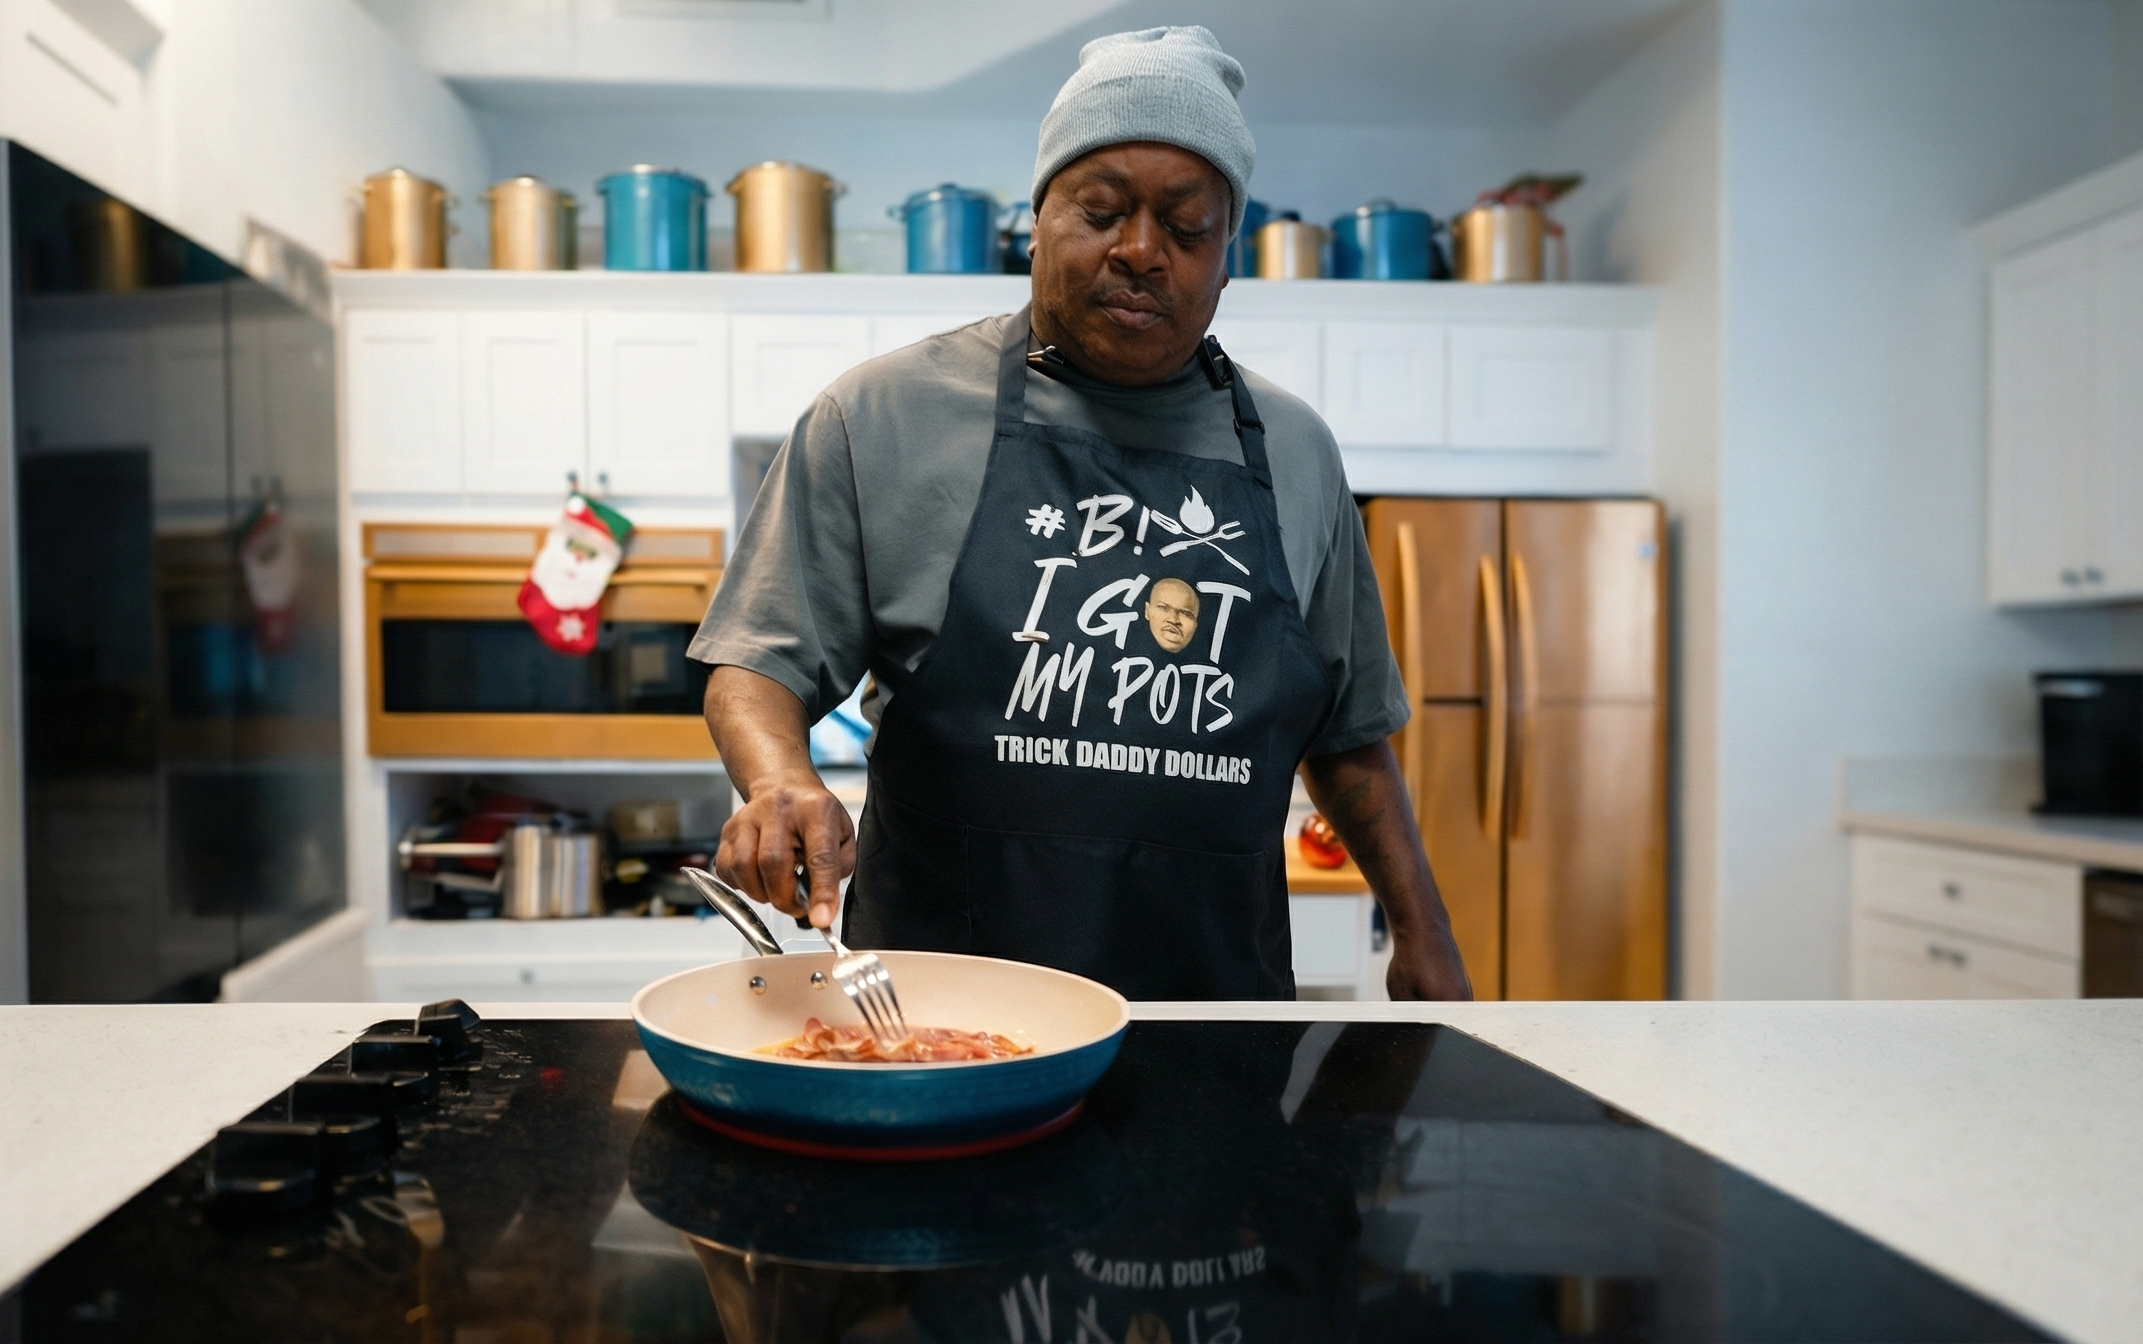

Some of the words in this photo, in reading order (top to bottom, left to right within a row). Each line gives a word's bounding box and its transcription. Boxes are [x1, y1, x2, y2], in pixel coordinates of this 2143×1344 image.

[1012, 557, 1078, 642] I
[1004, 642, 1095, 728] MY
[1107, 655, 1235, 735] POTS
[994, 734, 1069, 767] TRICK
[1076, 740, 1160, 776] DADDY
[1164, 750, 1252, 786] DOLLARS
